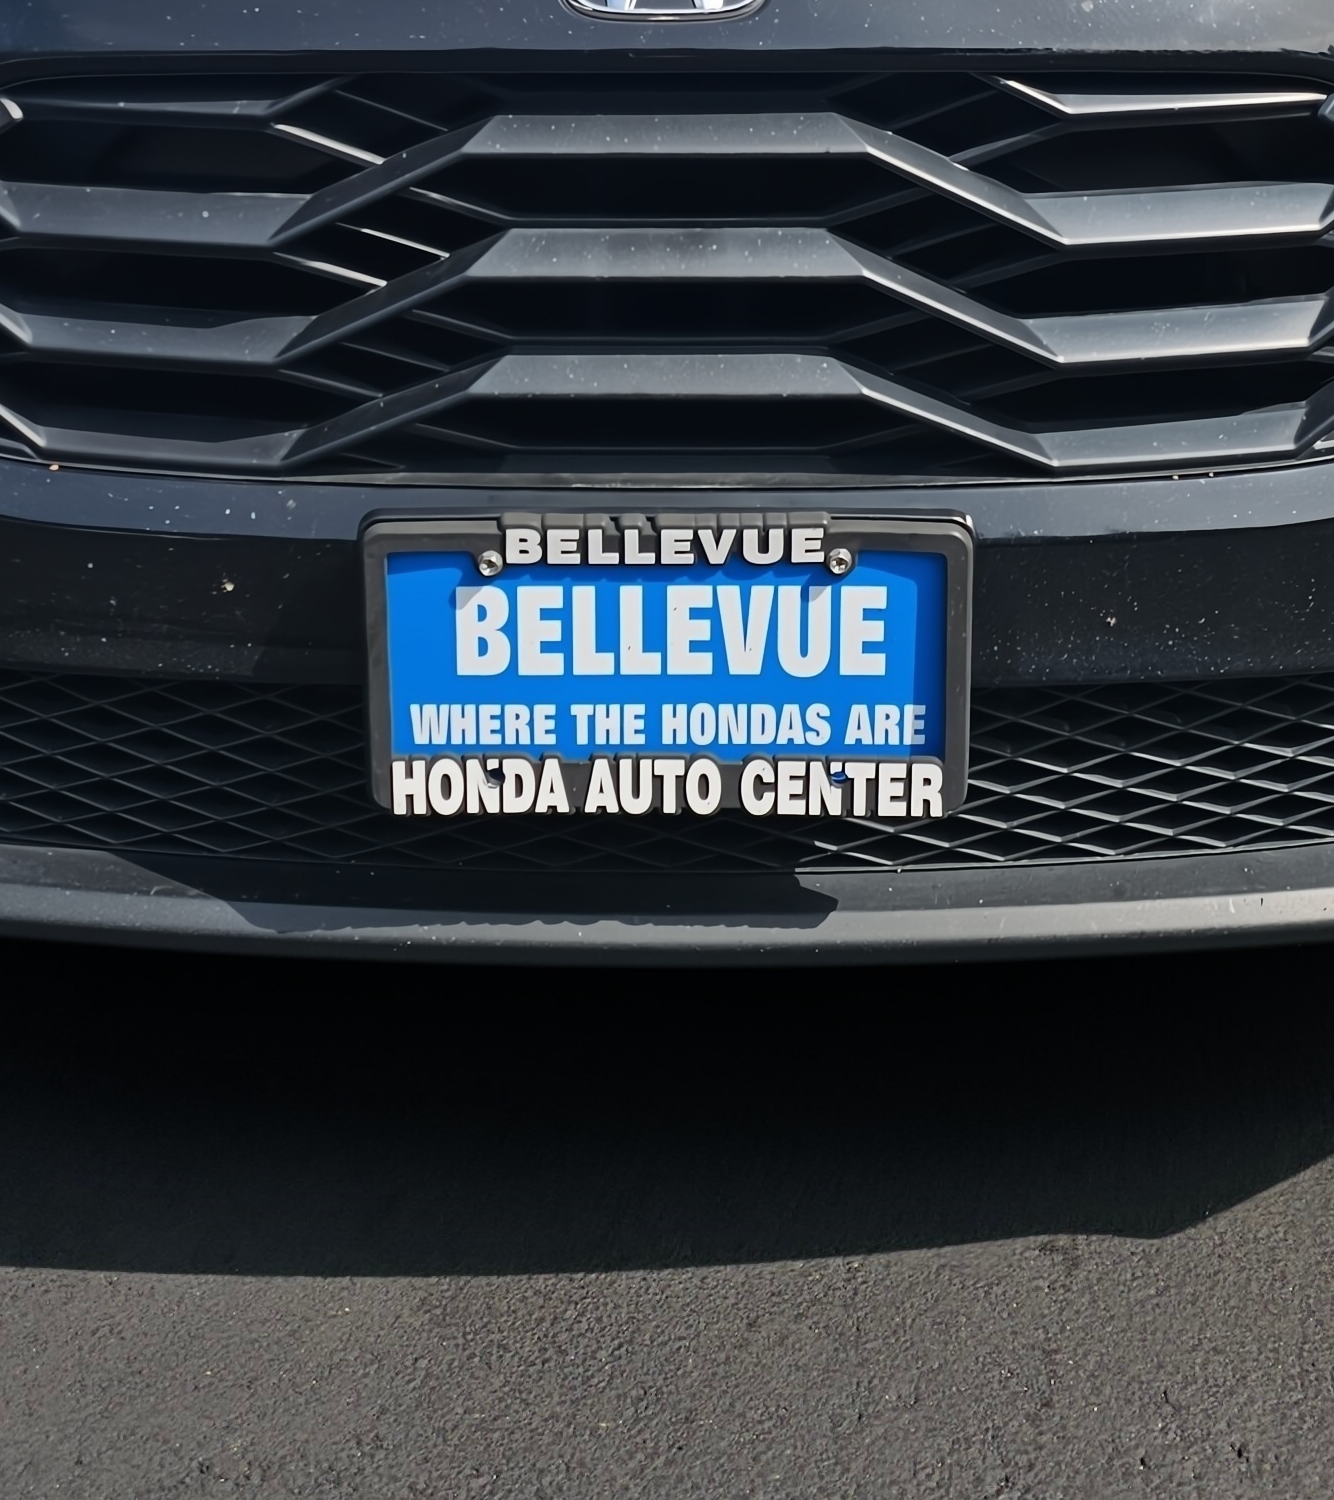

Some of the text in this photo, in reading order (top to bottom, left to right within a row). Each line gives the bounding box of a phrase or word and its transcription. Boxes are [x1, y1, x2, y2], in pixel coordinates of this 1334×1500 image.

[504, 527, 826, 566] BELLEVUE
[455, 584, 888, 678] BELLEVUE
[409, 703, 927, 747] WHERE THE HONDAS ARE
[391, 757, 944, 819] HONDA AUTO CENTER
